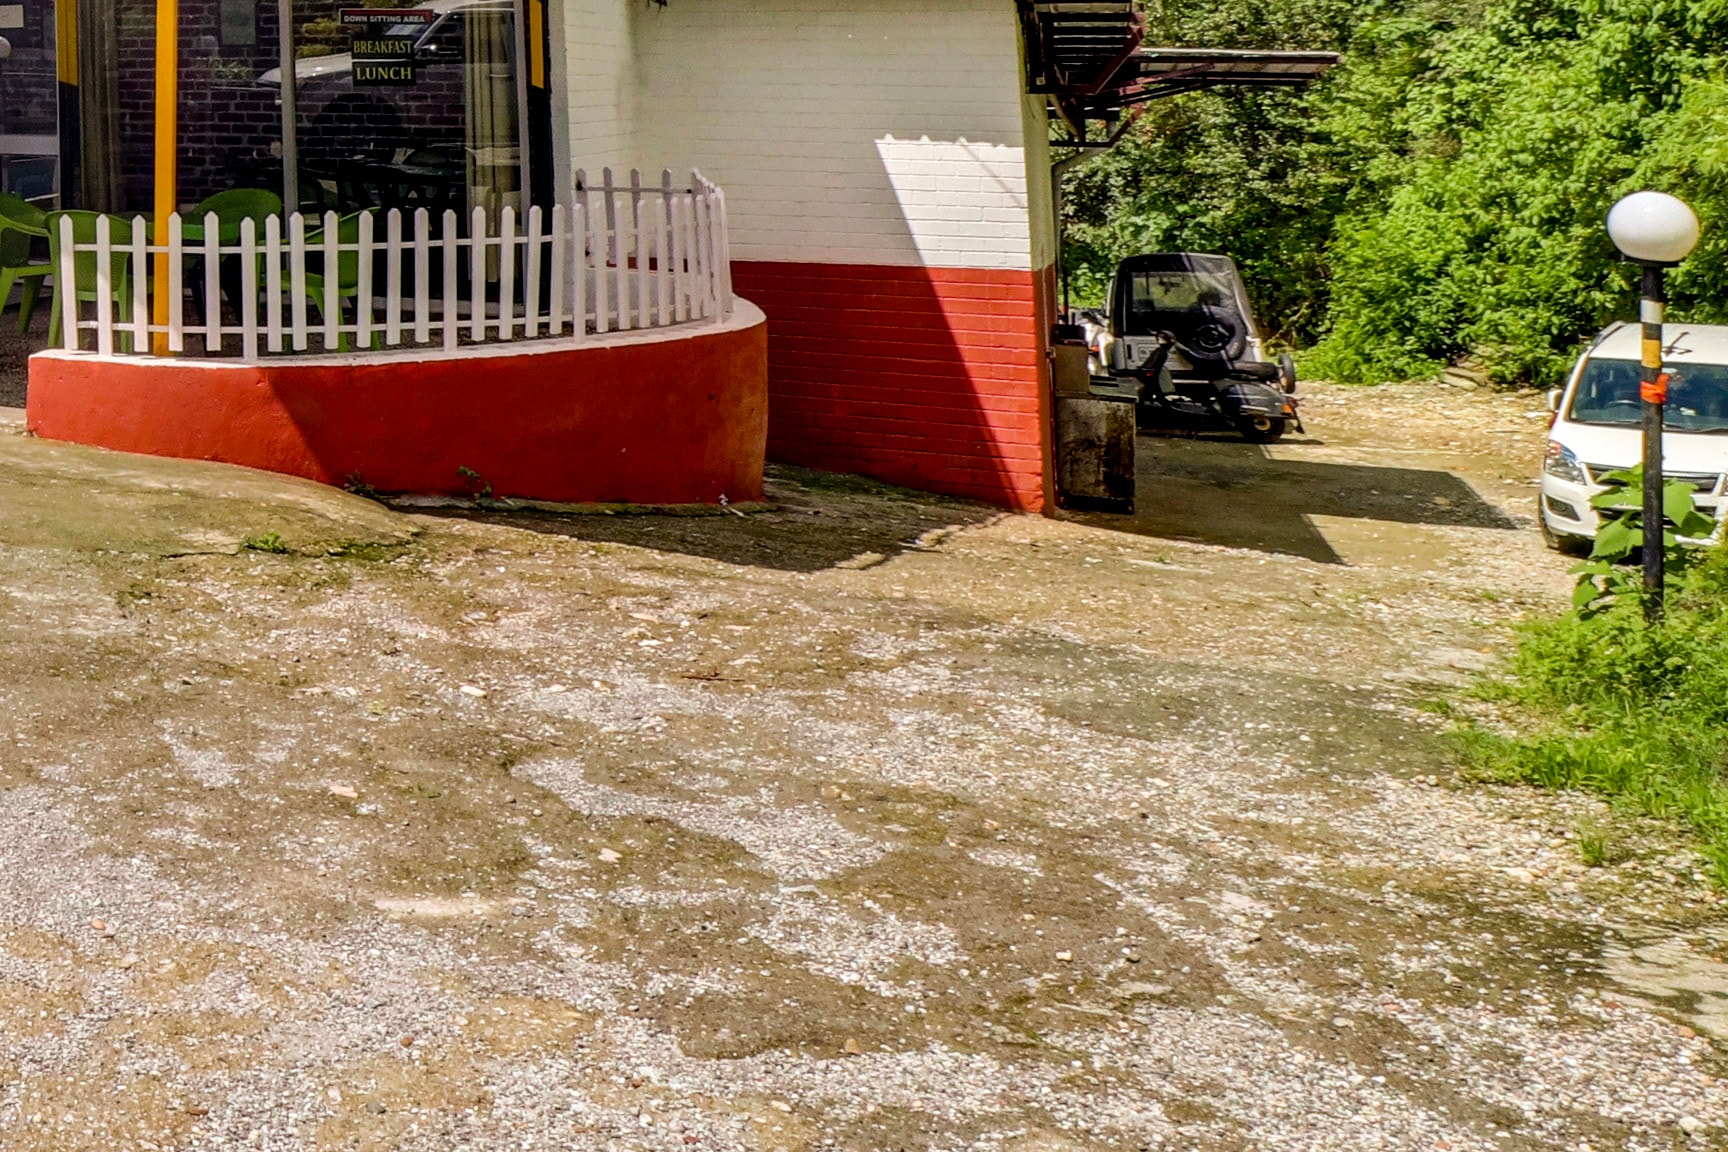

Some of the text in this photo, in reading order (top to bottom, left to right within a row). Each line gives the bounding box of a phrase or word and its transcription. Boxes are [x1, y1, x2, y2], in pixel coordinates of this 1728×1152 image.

[343, 15, 425, 23] DOWN SITTING AREA
[353, 40, 413, 54] BREAKFAST
[356, 66, 412, 80] LUNCH
